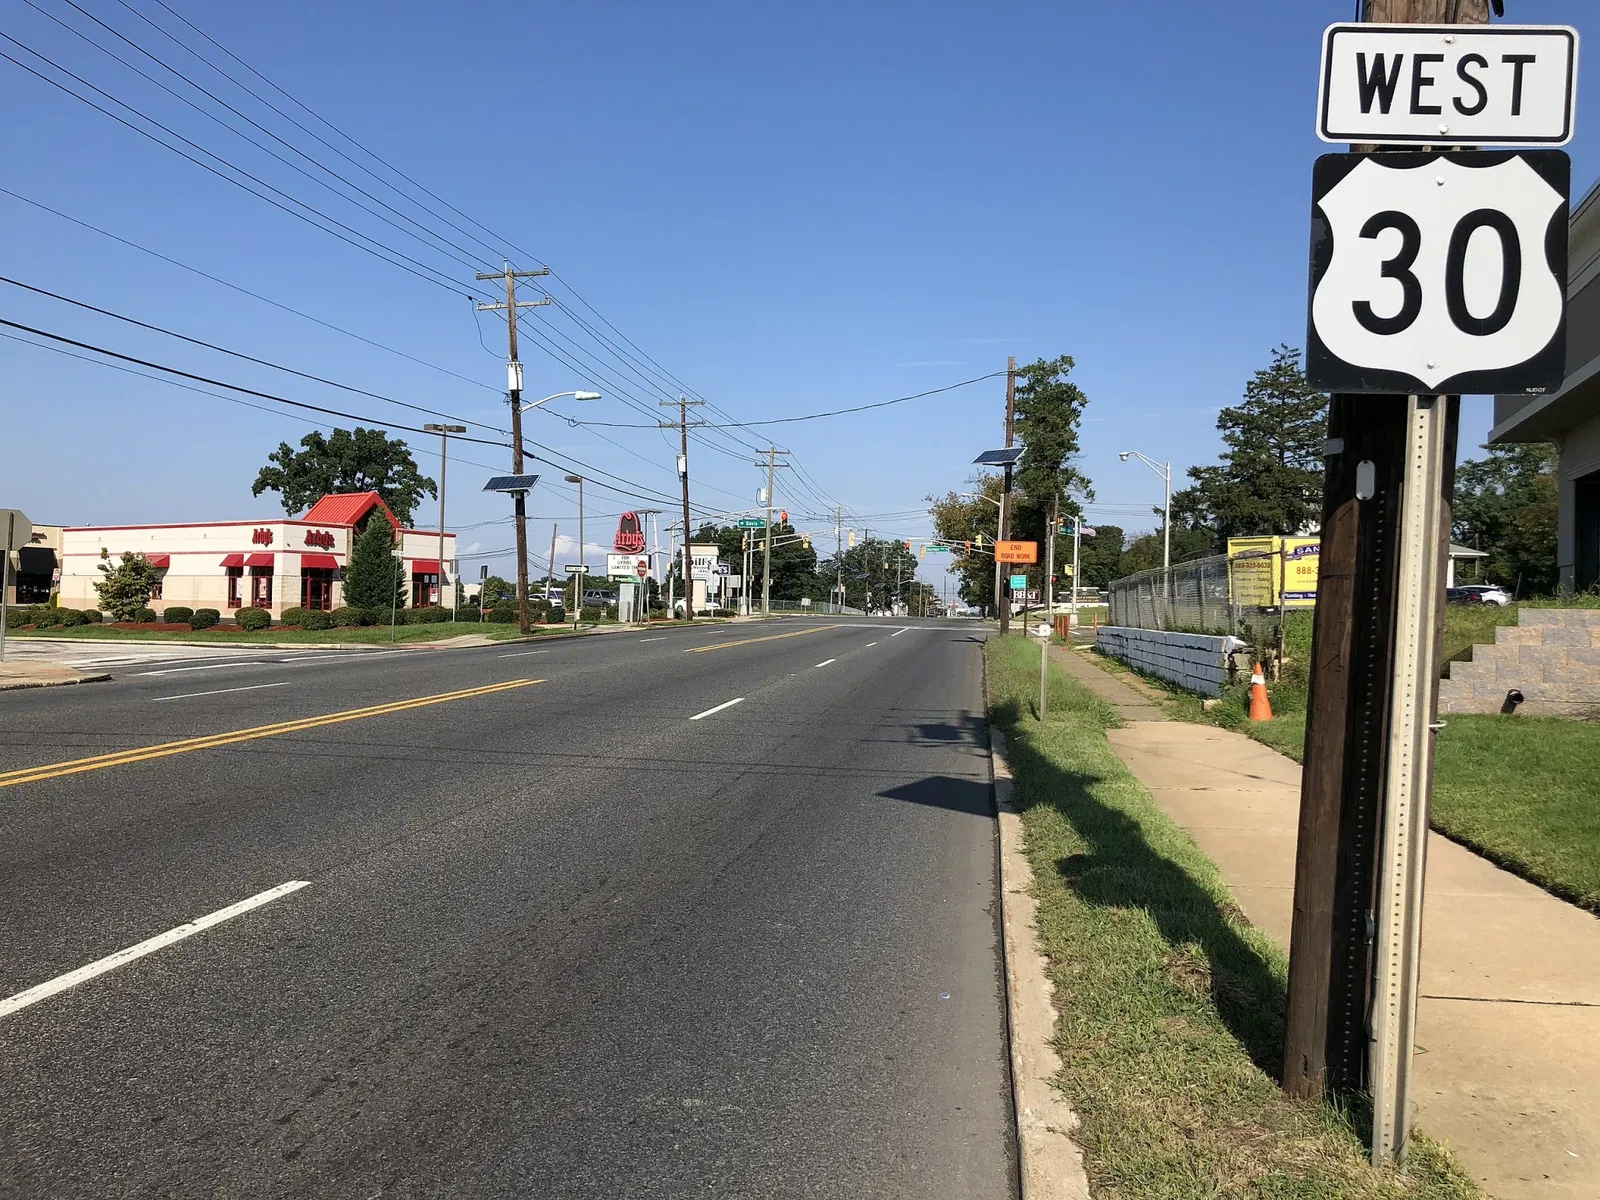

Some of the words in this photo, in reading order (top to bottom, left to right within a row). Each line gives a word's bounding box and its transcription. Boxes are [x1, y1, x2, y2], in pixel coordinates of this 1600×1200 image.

[1356, 53, 1536, 116] WEST
[1352, 208, 1522, 337] 30
[252, 528, 274, 548] Arby's
[304, 530, 336, 551] Arby's
[615, 530, 645, 548] Arby's
[1000, 552, 1015, 560] ROAD
